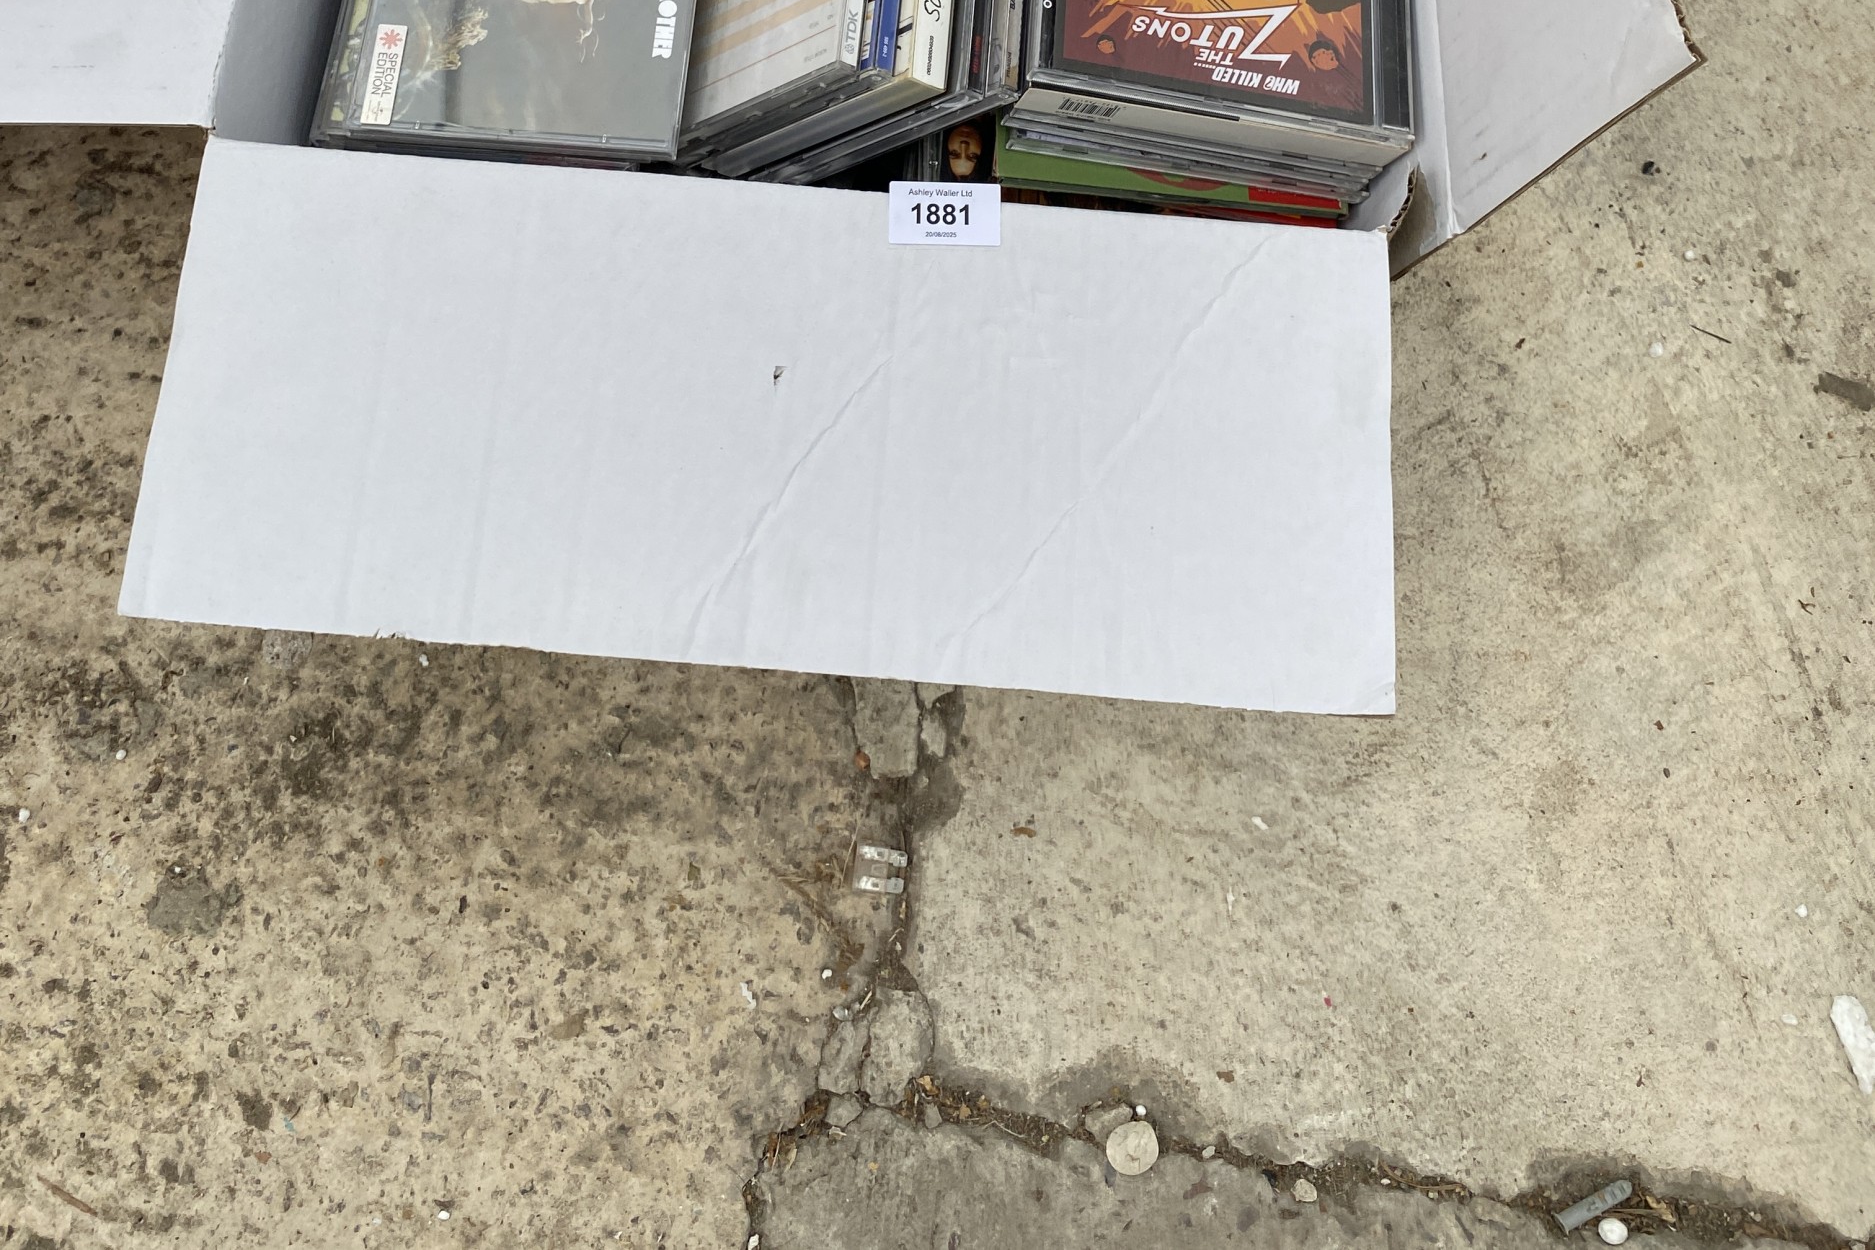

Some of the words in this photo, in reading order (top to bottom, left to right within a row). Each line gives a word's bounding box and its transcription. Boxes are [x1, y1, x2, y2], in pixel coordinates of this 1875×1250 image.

[845, 10, 858, 43] TDK
[1117, 3, 1300, 70] ZUTONS
[1195, 47, 1234, 65] THE
[371, 53, 388, 95] EDITION
[381, 53, 399, 98] SPECIAL
[908, 188, 934, 197] Ashley
[911, 202, 970, 225] 1881
